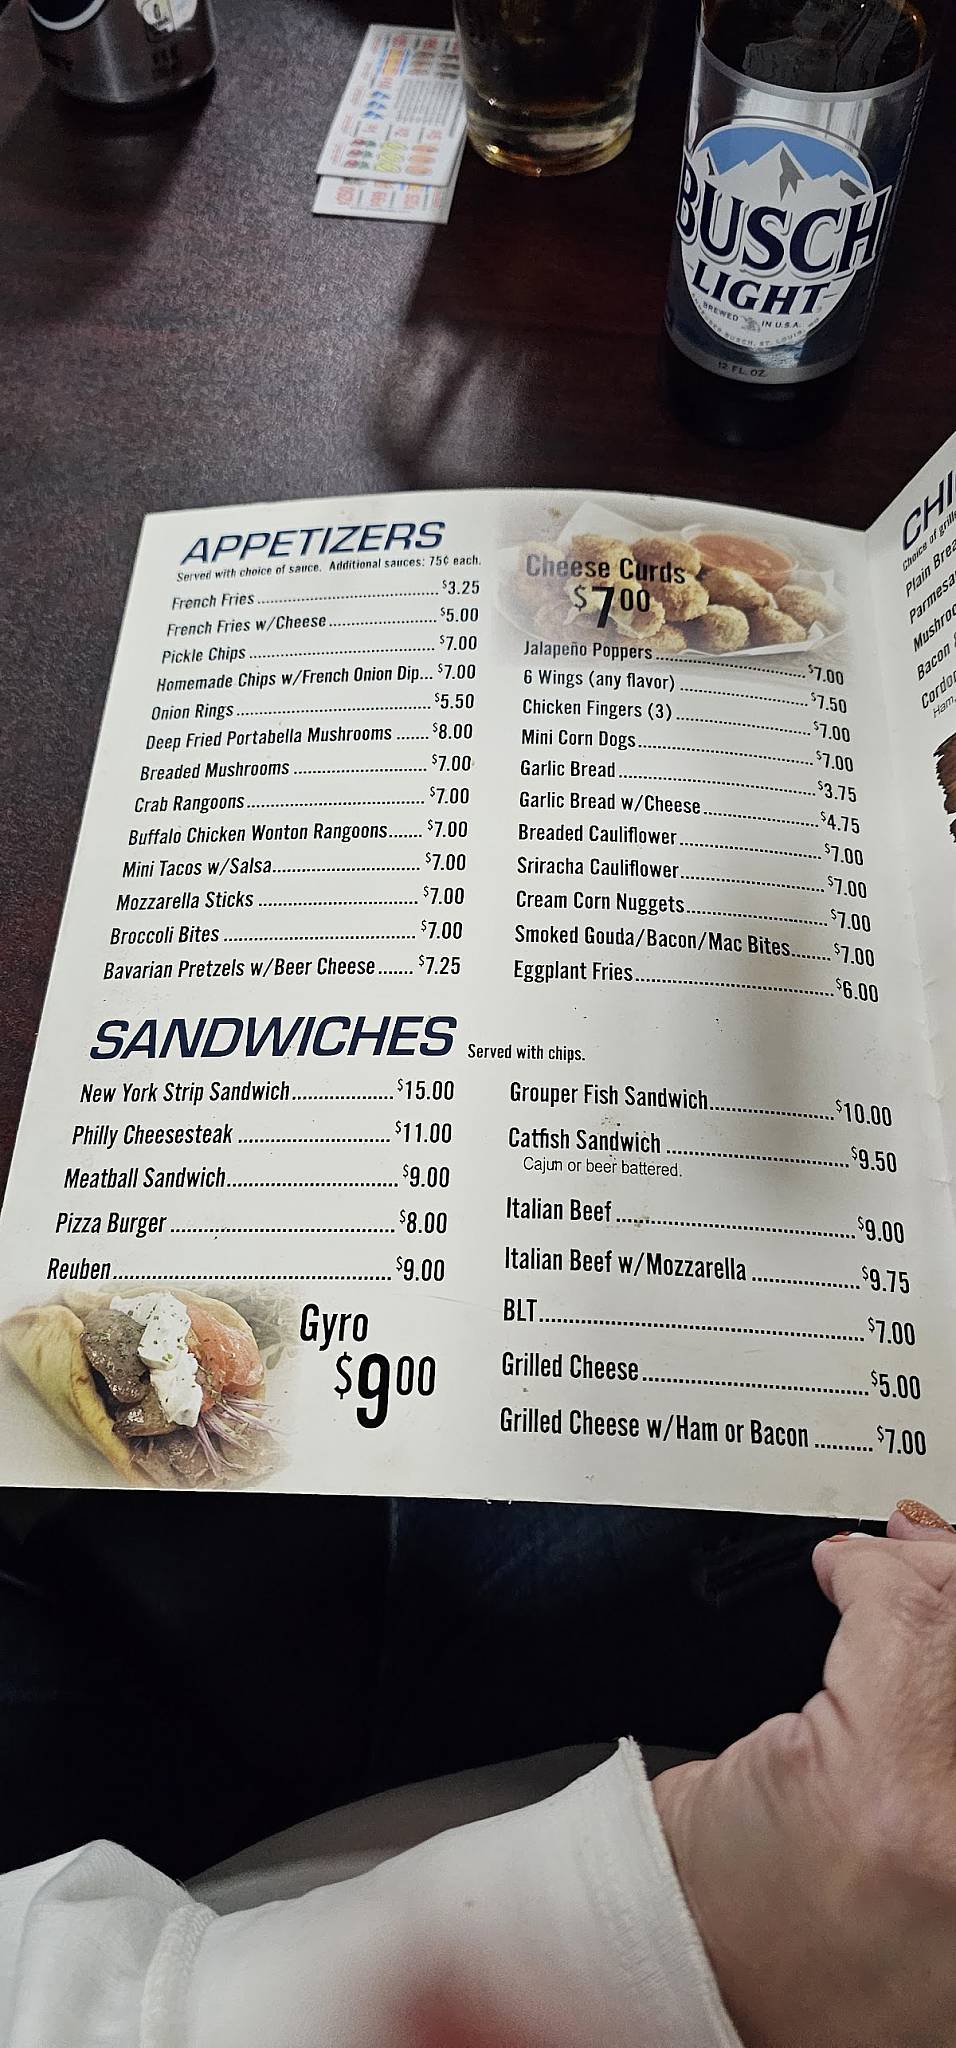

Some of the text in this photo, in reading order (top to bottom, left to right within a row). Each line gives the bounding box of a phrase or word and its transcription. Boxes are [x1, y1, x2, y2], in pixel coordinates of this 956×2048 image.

[677, 155, 890, 277] BUSCH
[691, 258, 832, 315] LIGHT
[703, 302, 739, 322] BREWED
[718, 361, 728, 369] 12
[903, 470, 956, 550] CHI
[180, 521, 446, 565] APPETIZERS
[902, 541, 928, 571] Choice
[929, 528, 937, 544] of
[176, 554, 481, 582] Served with choice of sauce. Additional sauces: 75¢ each.
[526, 551, 686, 587] Cheese Curds
[906, 565, 931, 598] Plain
[172, 579, 480, 611] French Fries $3.25
[910, 571, 956, 624] Parmesa
[167, 607, 478, 637] French Fries w/Cheese $5.00
[156, 674, 233, 692] Homemade
[238, 672, 276, 690] Chips
[282, 668, 349, 686] w/French
[354, 667, 392, 682] Onion
[438, 663, 476, 679] $7.00
[523, 640, 844, 685] Jalapeño Poppers $7.00
[917, 643, 951, 681] Bacon
[151, 692, 474, 721] Onion Rings $5.50
[524, 669, 847, 714] 6 Wings (any flavor) $7.50
[146, 722, 473, 752] Deep Fried Portabella Mushrooms $8.00
[523, 698, 850, 742] Chicken Fingers (3) $7.00
[140, 753, 471, 781] Breaded Mushrooms $7.00
[522, 729, 853, 772] Mini Corn Dogs $7.00
[128, 819, 467, 846] Buffalo Chicken Wonton Rangoons $7.00
[520, 791, 860, 834] Garlic Bread w/Cheese $4.75
[122, 852, 466, 878] Mini Tacos w/Salsa $7.00
[518, 824, 863, 866] Breaded Cauliflower $7.00
[517, 890, 871, 932] Cream Corn Nuggets $7.00
[103, 954, 460, 980] Bavarian Pretzels w/Beer Cheese $7.25
[515, 925, 874, 967] Smoked Gouda/Bacon/Mac Bites $7.00
[514, 960, 878, 1002] Eggplant Fries $6.00
[90, 1016, 457, 1060] SANDWICHES
[467, 1043, 585, 1064] Served with chips.
[80, 1078, 454, 1106] New York Strip Sandwich $15.00
[510, 1082, 892, 1126] Grouper Fish Sandwich $10.00
[72, 1120, 452, 1150] Philly Cheesesteak $11.00
[509, 1127, 897, 1173] Catfish Sandwich $9.50
[523, 1156, 682, 1177] Cajun or beer battered.
[55, 1209, 447, 1238] Pizza Burger $8.00
[505, 1246, 909, 1294] Italian Beef w/Mozzarella $9.75
[300, 1303, 368, 1351] Gyro
[504, 1298, 915, 1346] BLT $7.00
[502, 1351, 921, 1400] Grilled Cheese $5.00
[500, 1407, 926, 1456] Grilled Cheese w/Ham or Bacon $7.00
